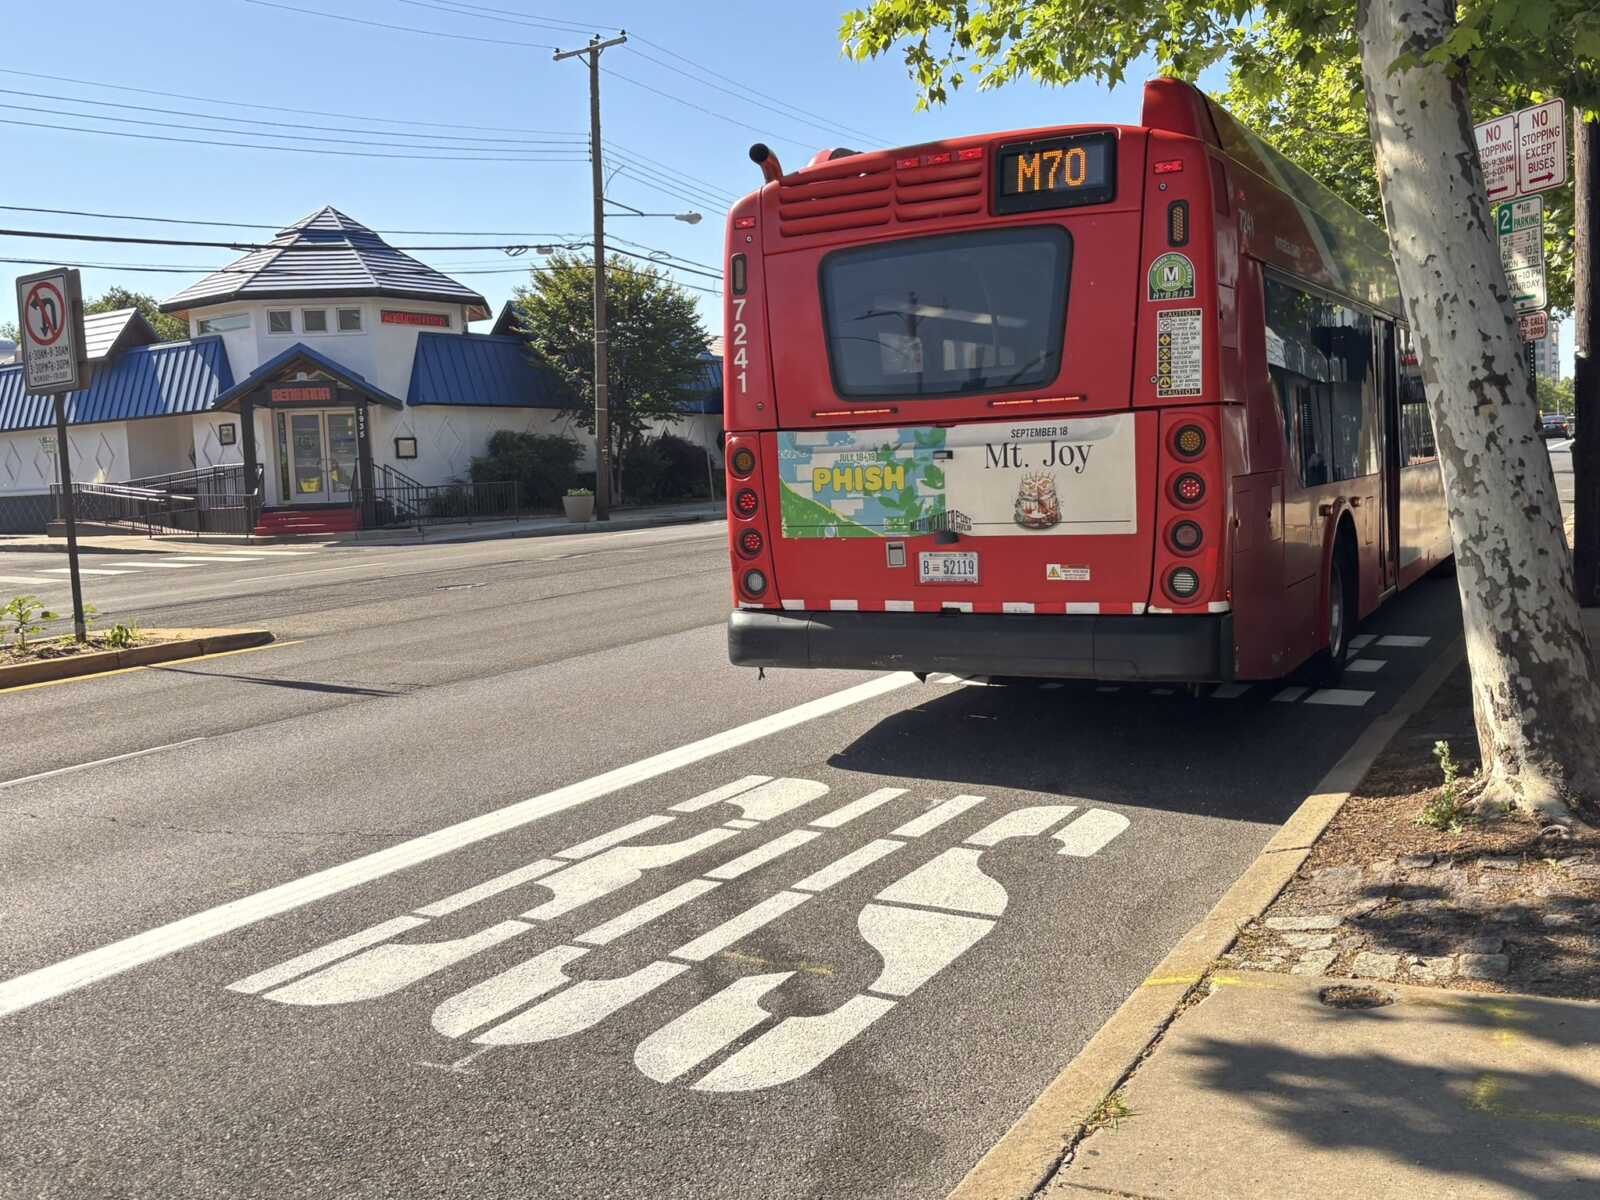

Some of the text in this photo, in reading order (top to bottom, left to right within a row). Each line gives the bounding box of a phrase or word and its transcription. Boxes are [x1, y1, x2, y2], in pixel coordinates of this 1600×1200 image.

[1532, 110, 1548, 129] NO
[1486, 125, 1502, 143] NO
[1522, 126, 1560, 146] STOPPING
[1480, 140, 1512, 158] TOPPING
[1526, 141, 1556, 160] EXCEPT
[1017, 147, 1087, 193] M70
[1528, 157, 1555, 174] BUSES
[1521, 202, 1531, 214] HR
[1501, 209, 1510, 230] 2
[1514, 213, 1539, 228] PARKING
[1527, 255, 1539, 266] FRI
[1164, 266, 1179, 282] M
[1508, 279, 1540, 291] ATURDAY
[1152, 289, 1191, 299] HYBRID
[1161, 310, 1198, 318] CAUTION
[733, 298, 749, 393] 7241
[1161, 388, 1197, 396] CAUTION
[1011, 426, 1068, 439] SEPTEMBER 18
[984, 439, 1095, 474] Mt. Joy
[812, 463, 906, 493] PHISH
[923, 560, 930, 575] B
[943, 559, 974, 575] 52119
[226, 774, 1131, 1092] BUS
